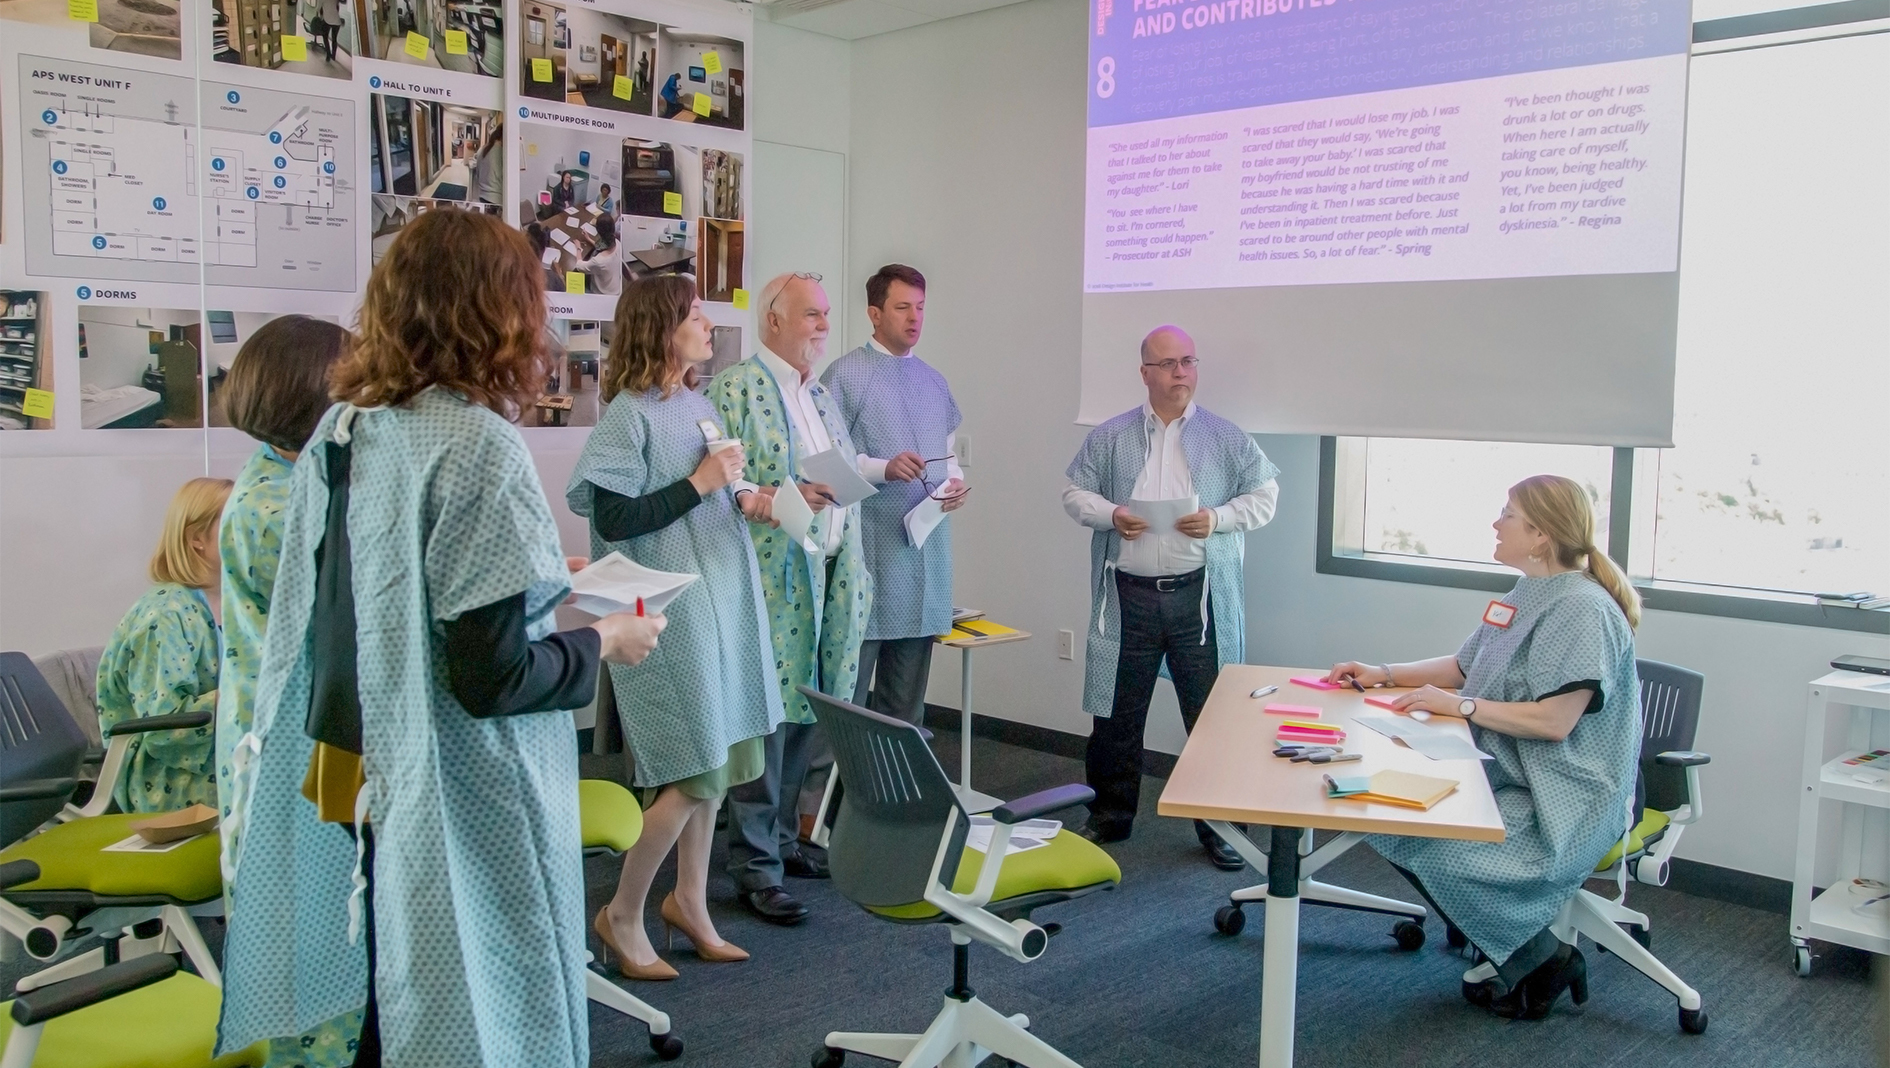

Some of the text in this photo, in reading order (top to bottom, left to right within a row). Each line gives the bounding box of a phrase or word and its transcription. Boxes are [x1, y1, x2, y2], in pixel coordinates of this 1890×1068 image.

[1133, 12, 1176, 39] AND
[1181, 0, 1337, 30] CONTRIBU
[32, 70, 55, 80] APS
[58, 74, 91, 85] WEST
[94, 78, 122, 89] UNIT
[1097, 56, 1116, 98] 8
[383, 80, 406, 91] HALL
[408, 84, 421, 92] TO
[423, 85, 444, 96] UNIT
[1532, 94, 1561, 105] been
[1566, 87, 1615, 102] thought
[1619, 86, 1623, 95] I
[1627, 85, 1650, 94] was
[531, 110, 590, 126] MULTIPURPOSE
[592, 120, 615, 130] ROOM
[1503, 112, 1537, 126] drunk
[1550, 110, 1566, 120] lot
[1570, 110, 1584, 119] or
[1588, 108, 1604, 117] on
[1607, 104, 1645, 117] drugs.
[1130, 140, 1149, 150] used
[1150, 138, 1160, 148] all
[1162, 139, 1175, 149] my
[1177, 131, 1228, 144] information
[1243, 141, 1273, 153] scared
[1275, 140, 1294, 149] that
[1297, 137, 1319, 149] they
[1321, 132, 1352, 144] would
[1354, 133, 1371, 144] say,
[1410, 124, 1441, 139] going
[1504, 120, 1650, 143] When here I am actually
[1108, 158, 1124, 167] that
[1131, 154, 1156, 165] talked
[1169, 152, 1183, 160] her
[1185, 149, 1210, 159] about
[1502, 139, 1630, 162] taking care of myself,
[1107, 172, 1136, 184] against
[1153, 168, 1165, 177] for
[1168, 166, 1189, 176] them
[1204, 162, 1222, 172] take
[1242, 176, 1256, 186] my
[1258, 169, 1304, 184] boyfriend
[1306, 166, 1336, 178] would
[1338, 166, 1350, 175] be
[1353, 165, 1370, 174] not
[1374, 160, 1415, 173] trusting
[1418, 157, 1430, 168] of
[1500, 157, 1648, 182] you know, being healthy.
[1107, 189, 1120, 198] my
[1172, 180, 1189, 190] Lori
[1502, 186, 1521, 197] Yet,
[1548, 182, 1577, 192] been
[1579, 177, 1624, 194] judged
[1146, 206, 1171, 214] where
[1178, 203, 1198, 212] have
[1509, 202, 1524, 212] lot
[1528, 200, 1556, 211] from
[1560, 201, 1580, 212] my
[1582, 196, 1626, 208] tardive
[1117, 223, 1128, 232] sit.
[1146, 218, 1185, 229] cornered,
[1578, 214, 1622, 229] Regina
[1106, 237, 1148, 247] something
[1150, 234, 1173, 244] could
[1240, 235, 1270, 246] scared
[1285, 234, 1297, 243] be
[1299, 231, 1334, 242] around
[1337, 230, 1365, 240] other
[1366, 227, 1403, 242] people
[1406, 226, 1428, 236] with
[1431, 223, 1469, 235] mental
[1113, 251, 1160, 260] Prosecutor
[1172, 248, 1192, 257] ASH
[96, 290, 136, 300] DORMS
